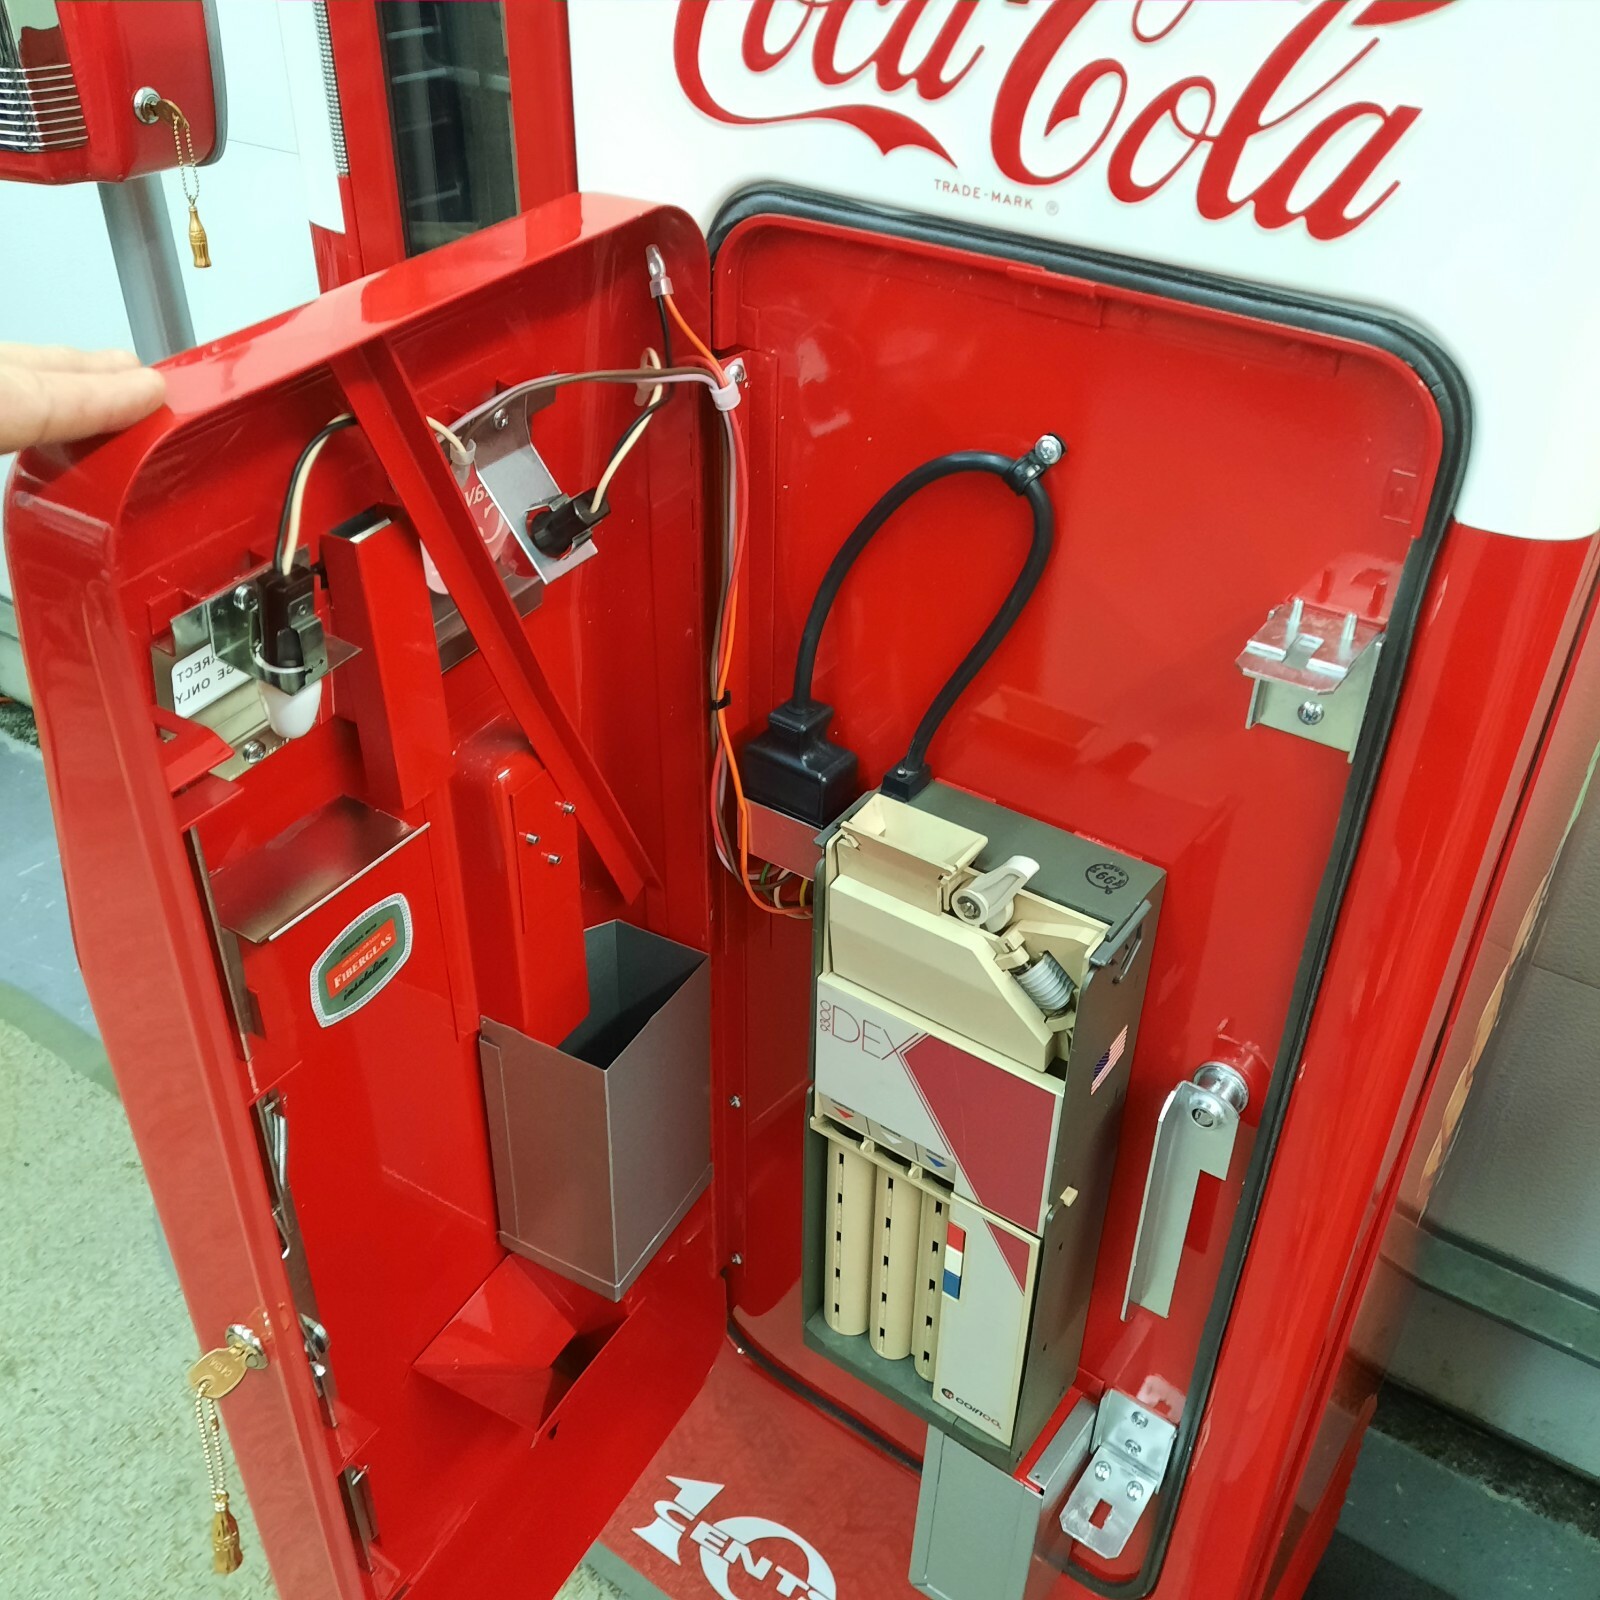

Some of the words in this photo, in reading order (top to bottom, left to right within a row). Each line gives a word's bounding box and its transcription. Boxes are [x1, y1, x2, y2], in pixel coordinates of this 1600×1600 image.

[934, 178, 1033, 210] TRADE-MARK
[820, 1000, 831, 1032] 9300
[832, 1005, 919, 1061] DEX
[653, 1500, 836, 1600] CENT
